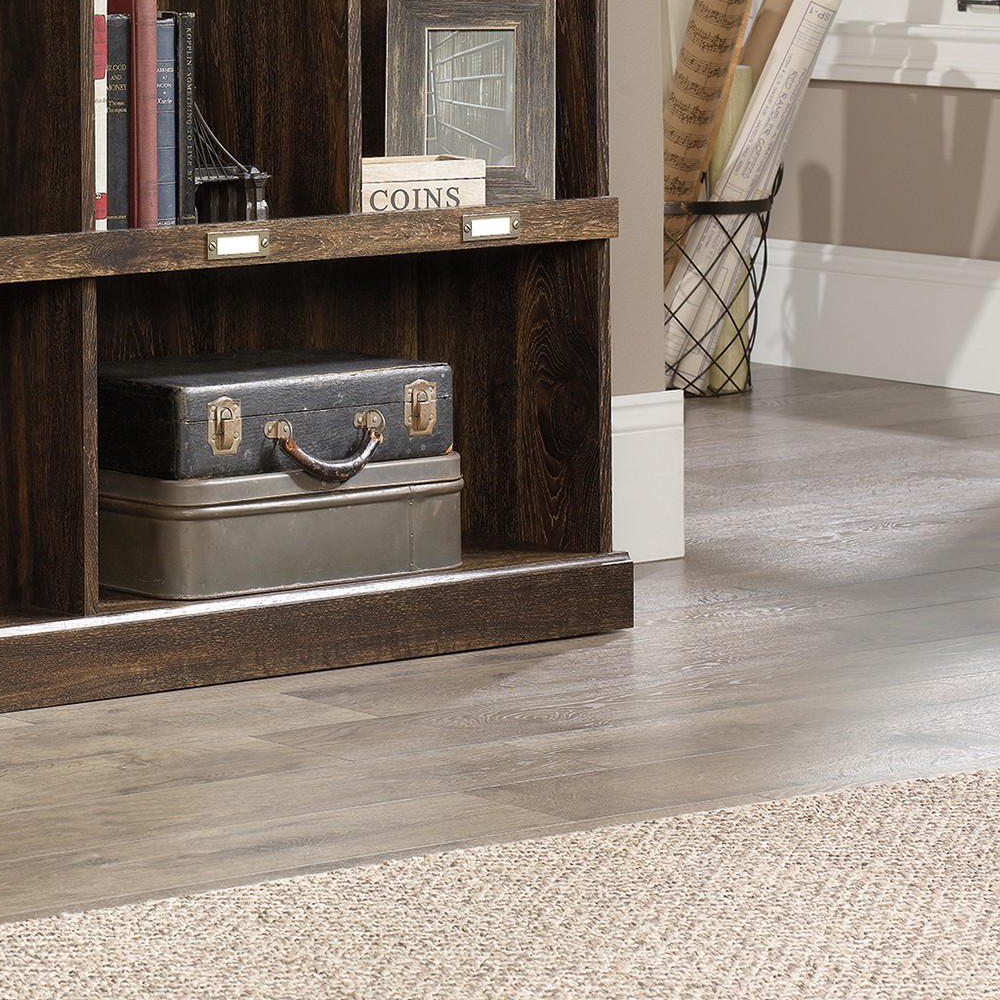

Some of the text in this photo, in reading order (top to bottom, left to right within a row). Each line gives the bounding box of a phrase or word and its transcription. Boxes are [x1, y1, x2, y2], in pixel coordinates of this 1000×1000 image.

[809, 6, 831, 22] SP-1
[783, 69, 799, 90] RED
[761, 91, 788, 137] RAMBLER
[186, 129, 193, 142] TO
[741, 136, 767, 181] COFFEES
[186, 170, 193, 182] BY
[370, 187, 461, 210] COINS
